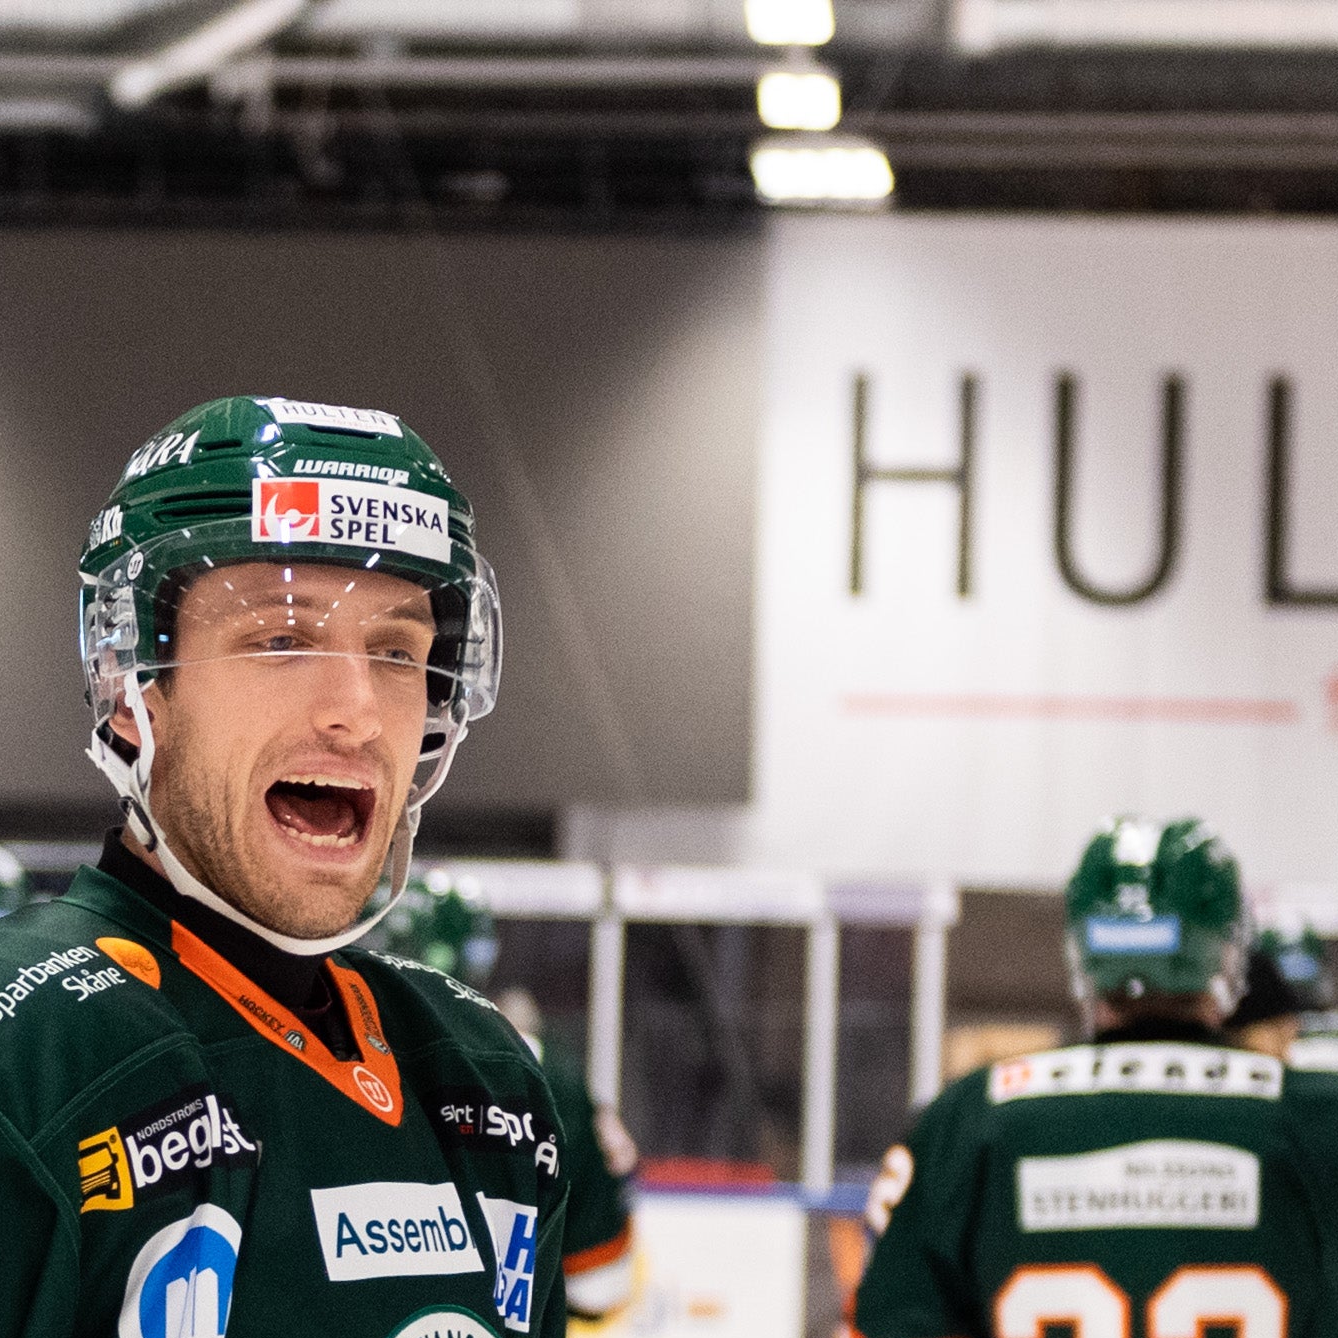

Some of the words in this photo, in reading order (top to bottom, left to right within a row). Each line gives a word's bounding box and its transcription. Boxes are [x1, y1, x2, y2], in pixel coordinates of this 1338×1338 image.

[293, 459, 410, 485] WARRIOR
[330, 494, 443, 533] SVENSKA
[330, 519, 397, 545] SPEL
[61, 966, 127, 1002] Skåne
[136, 1097, 205, 1142] NORDSTRÖMS
